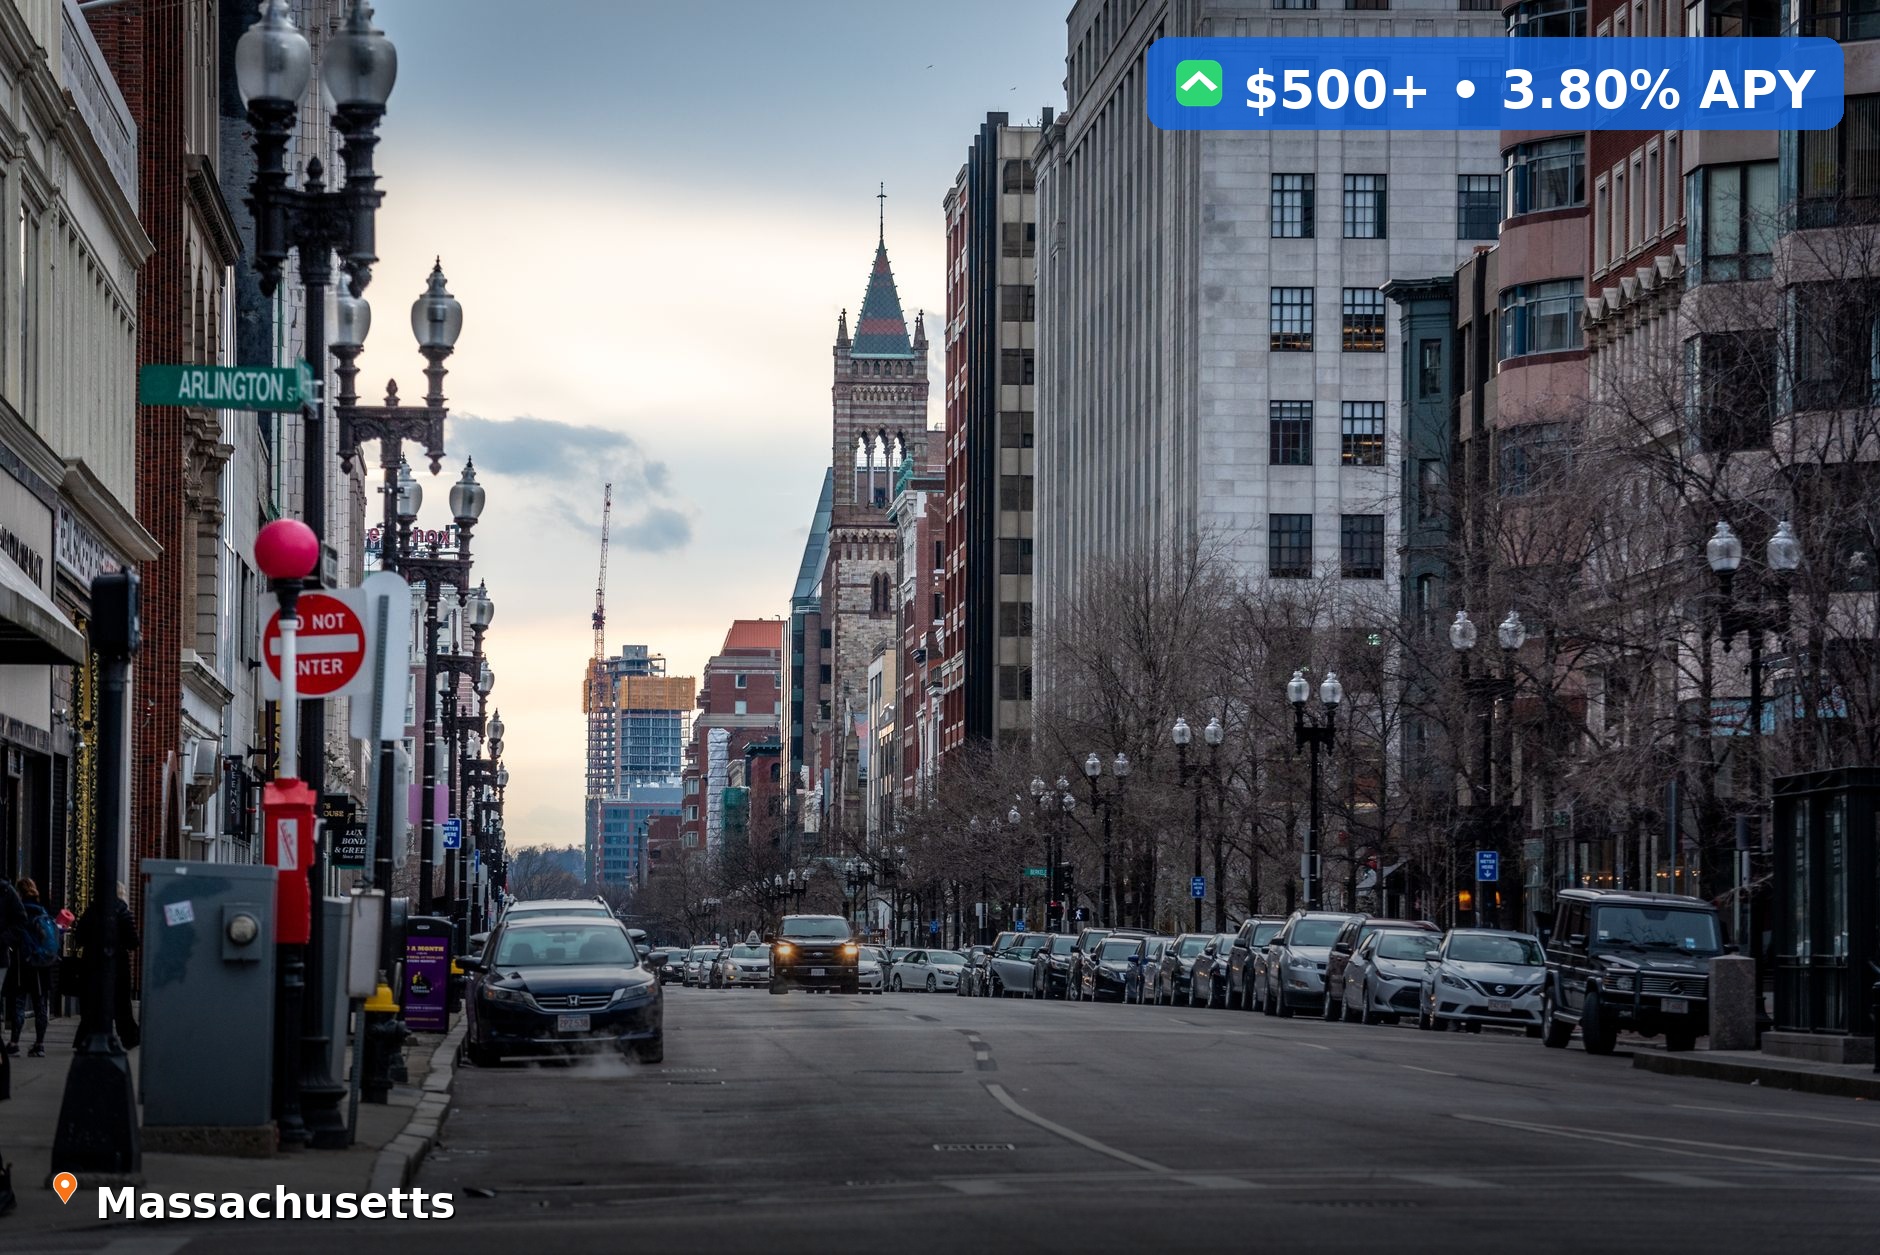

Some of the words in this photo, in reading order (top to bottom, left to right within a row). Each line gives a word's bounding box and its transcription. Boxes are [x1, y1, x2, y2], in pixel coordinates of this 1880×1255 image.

[178, 371, 284, 402] ARLINGTON
[412, 527, 450, 545] nox
[312, 612, 345, 630] NOT
[297, 658, 343, 676] NTER
[229, 763, 238, 814] NEENAS
[341, 837, 367, 845] BOND
[345, 828, 364, 836] LUX
[342, 846, 367, 854] GREE
